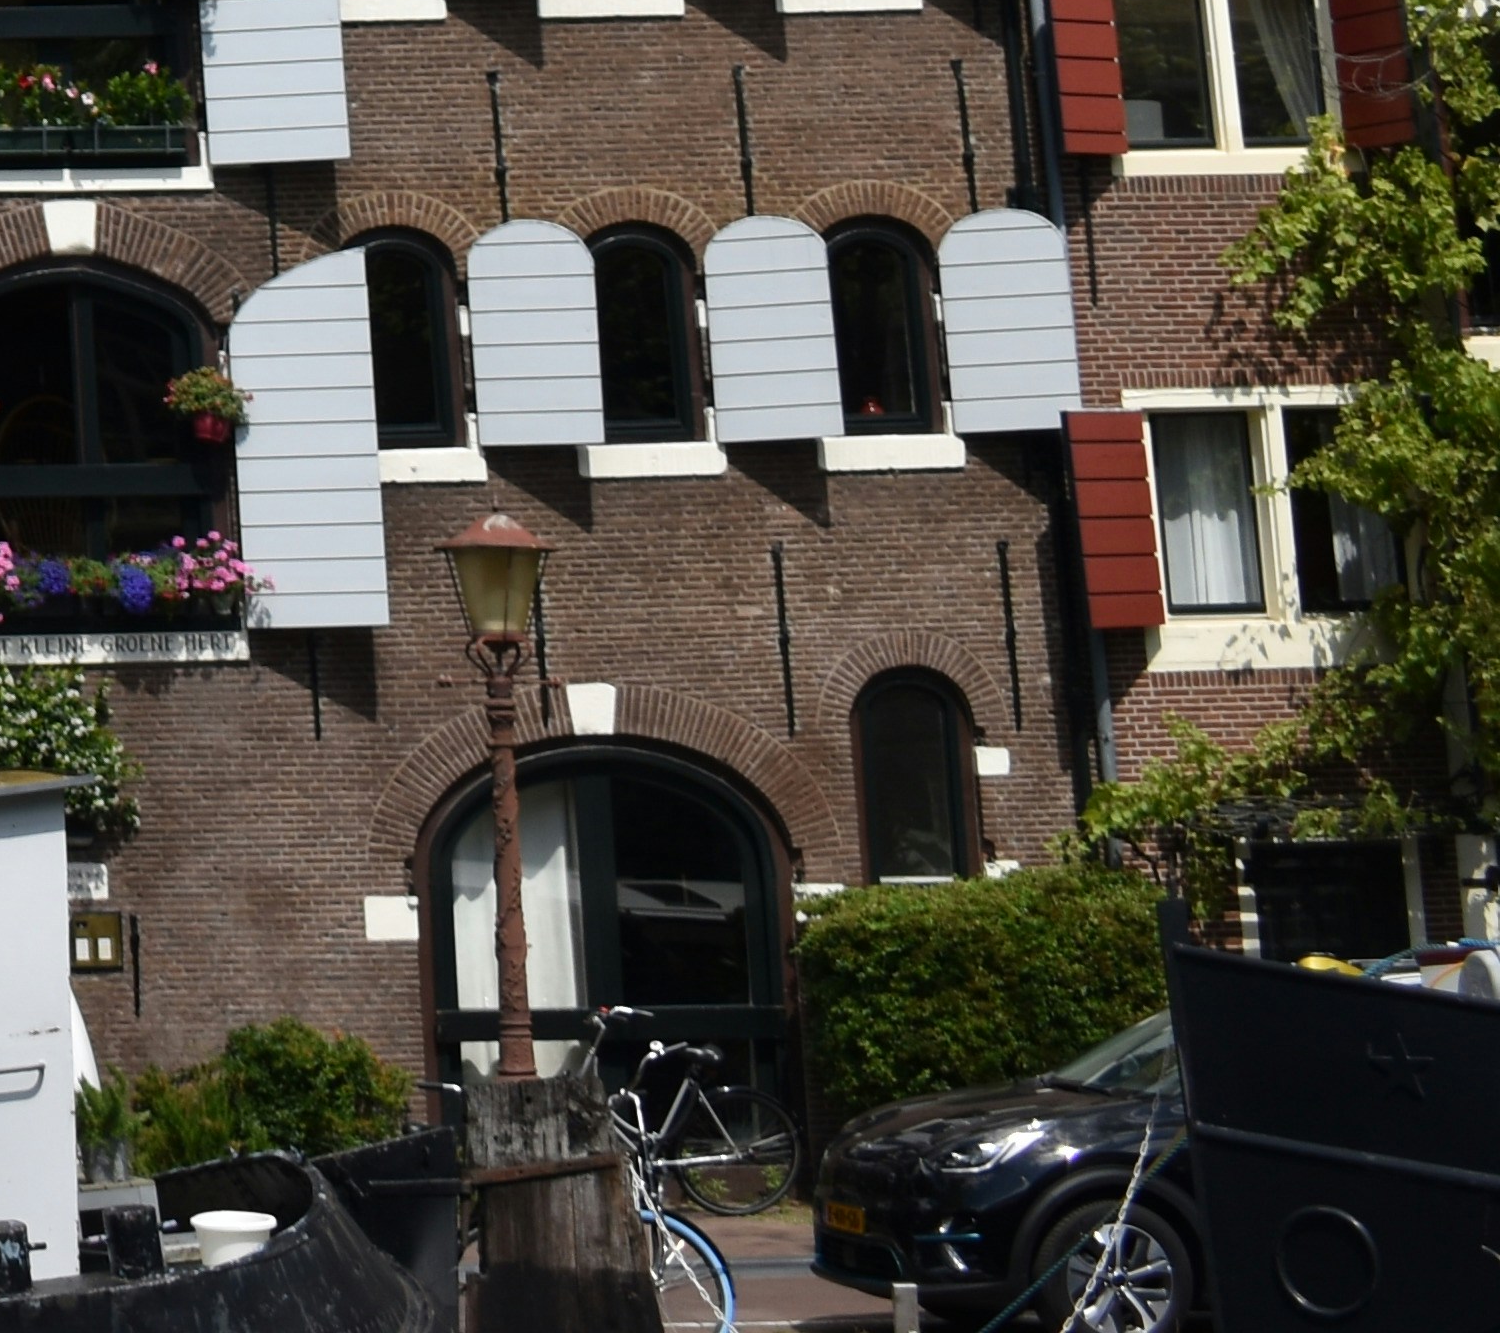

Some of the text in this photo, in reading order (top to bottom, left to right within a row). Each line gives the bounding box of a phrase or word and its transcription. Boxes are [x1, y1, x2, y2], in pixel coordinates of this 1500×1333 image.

[20, 636, 91, 655] KLEINE
[100, 633, 174, 653] GROENE
[183, 632, 236, 652] HERT
